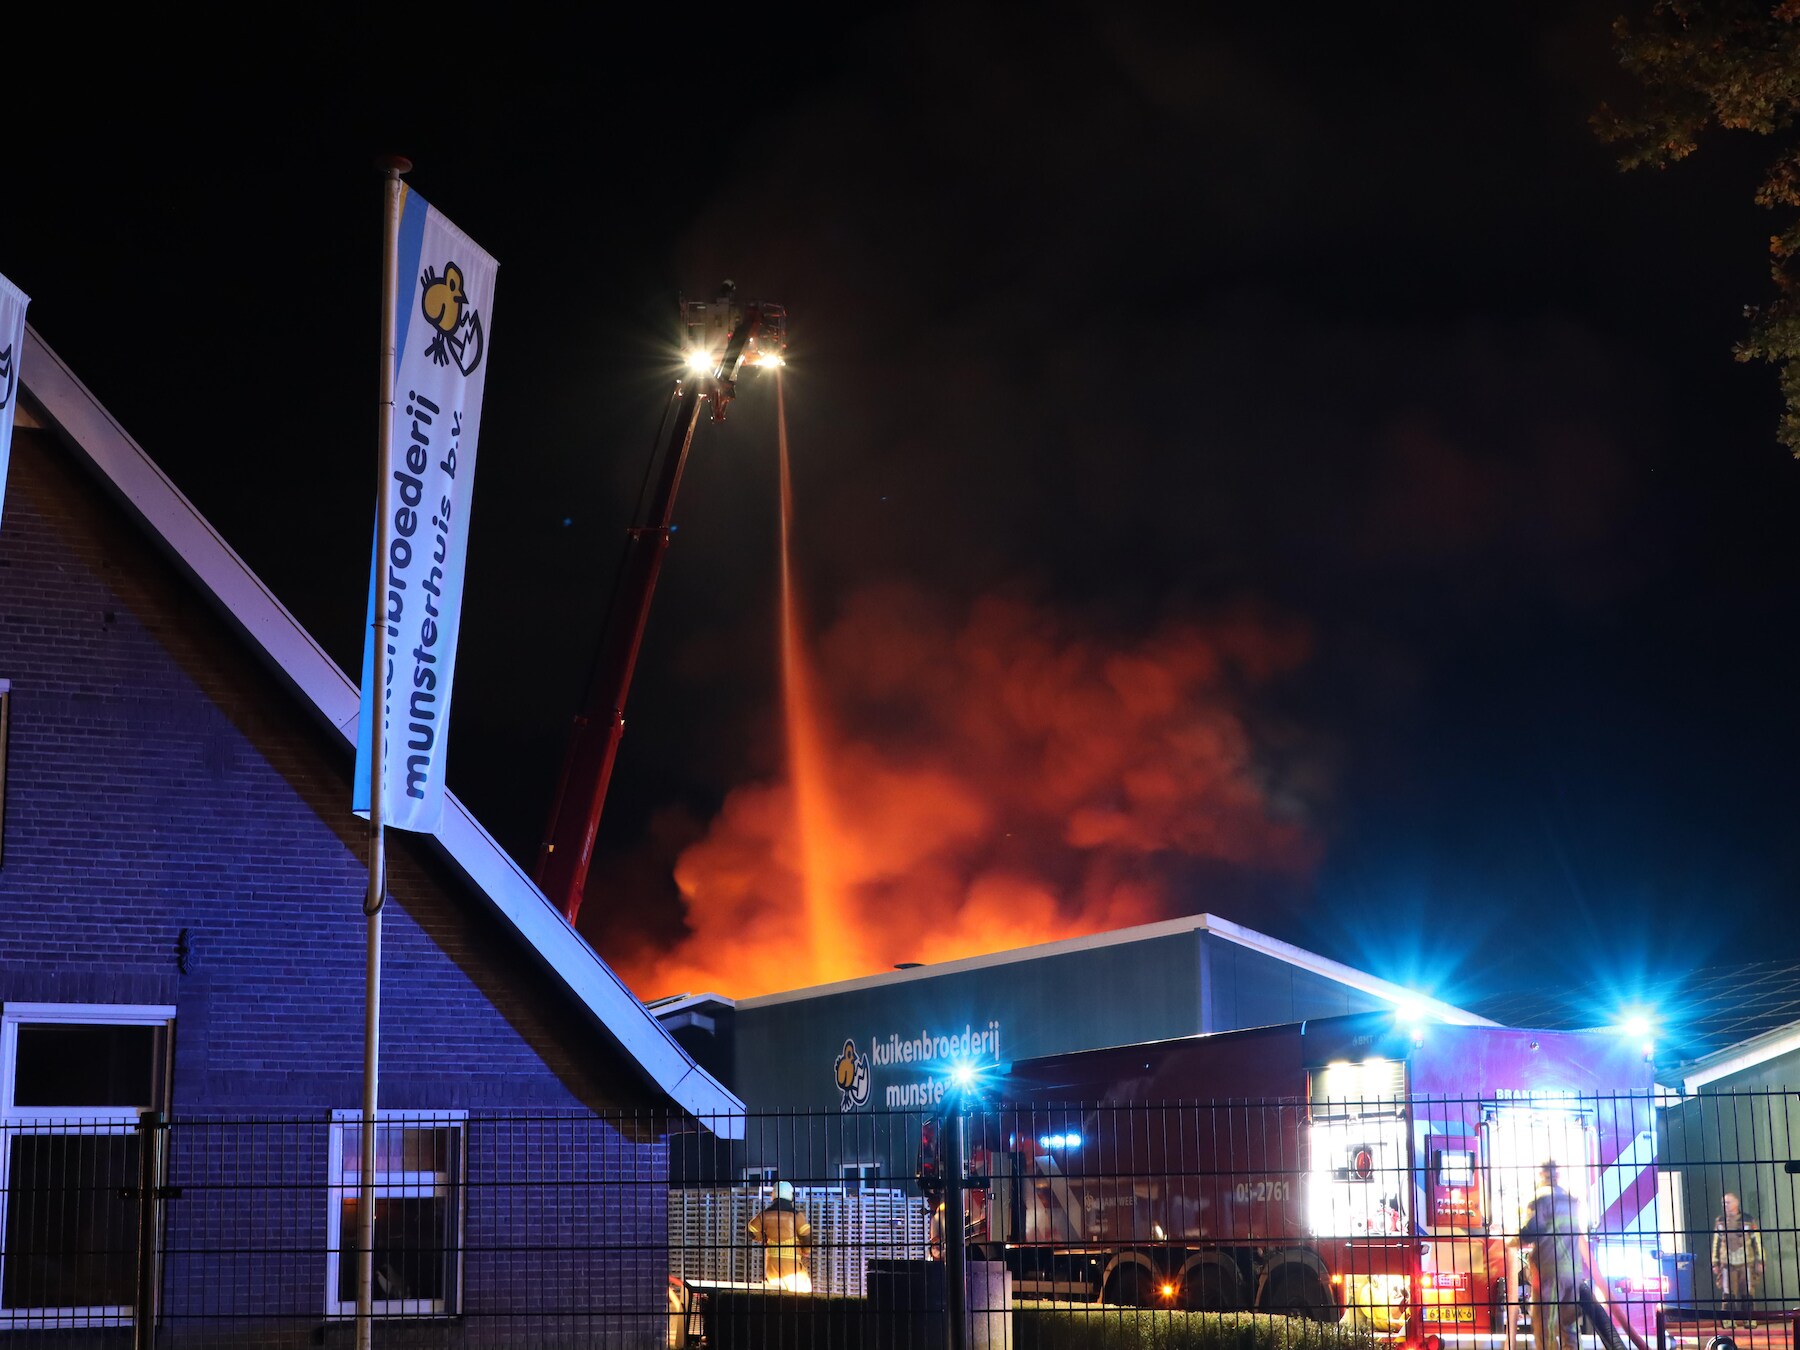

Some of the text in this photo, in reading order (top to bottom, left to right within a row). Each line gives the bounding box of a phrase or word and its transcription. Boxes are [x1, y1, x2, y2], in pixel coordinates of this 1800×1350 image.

[382, 390, 440, 791] broederij
[406, 410, 463, 800] munsterhuis b.v.
[872, 1020, 1000, 1066] kuikenbroederij
[886, 1076, 956, 1107] munster
[1236, 1181, 1290, 1202] 05-2761
